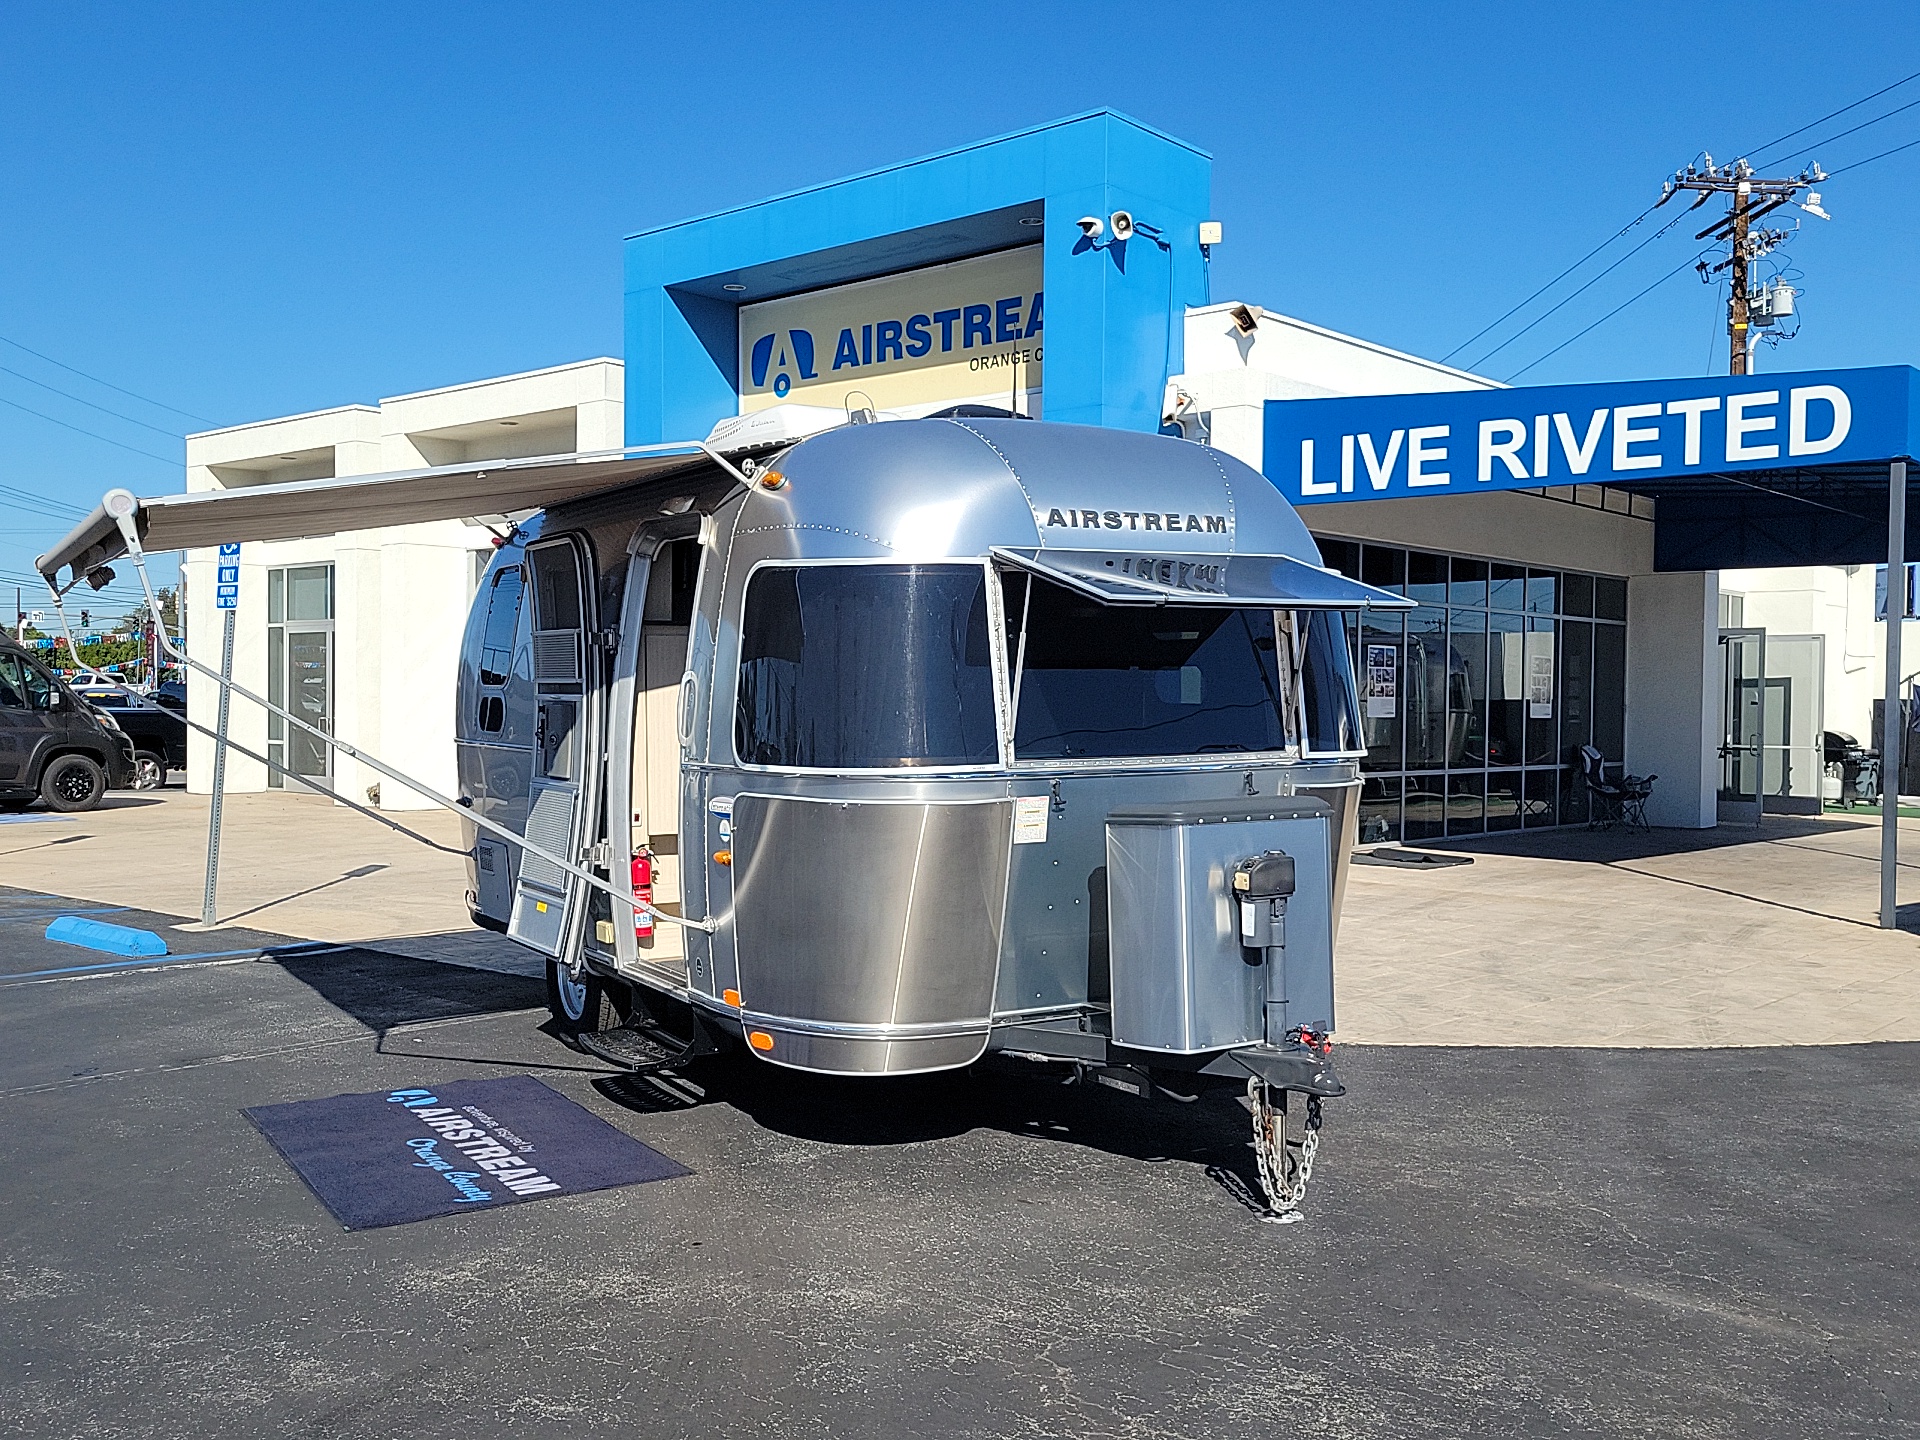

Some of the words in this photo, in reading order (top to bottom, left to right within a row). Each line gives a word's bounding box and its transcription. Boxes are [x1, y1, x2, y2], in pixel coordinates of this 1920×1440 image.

[970, 349, 1031, 371] ORANGE
[1301, 425, 1450, 496] LIVE
[1477, 385, 1852, 481] RIVETED
[1047, 508, 1227, 534] AIRSTREAM
[406, 1138, 453, 1171] Orange
[443, 1171, 492, 1203] County
[410, 1107, 562, 1195] AIRSTREAM
